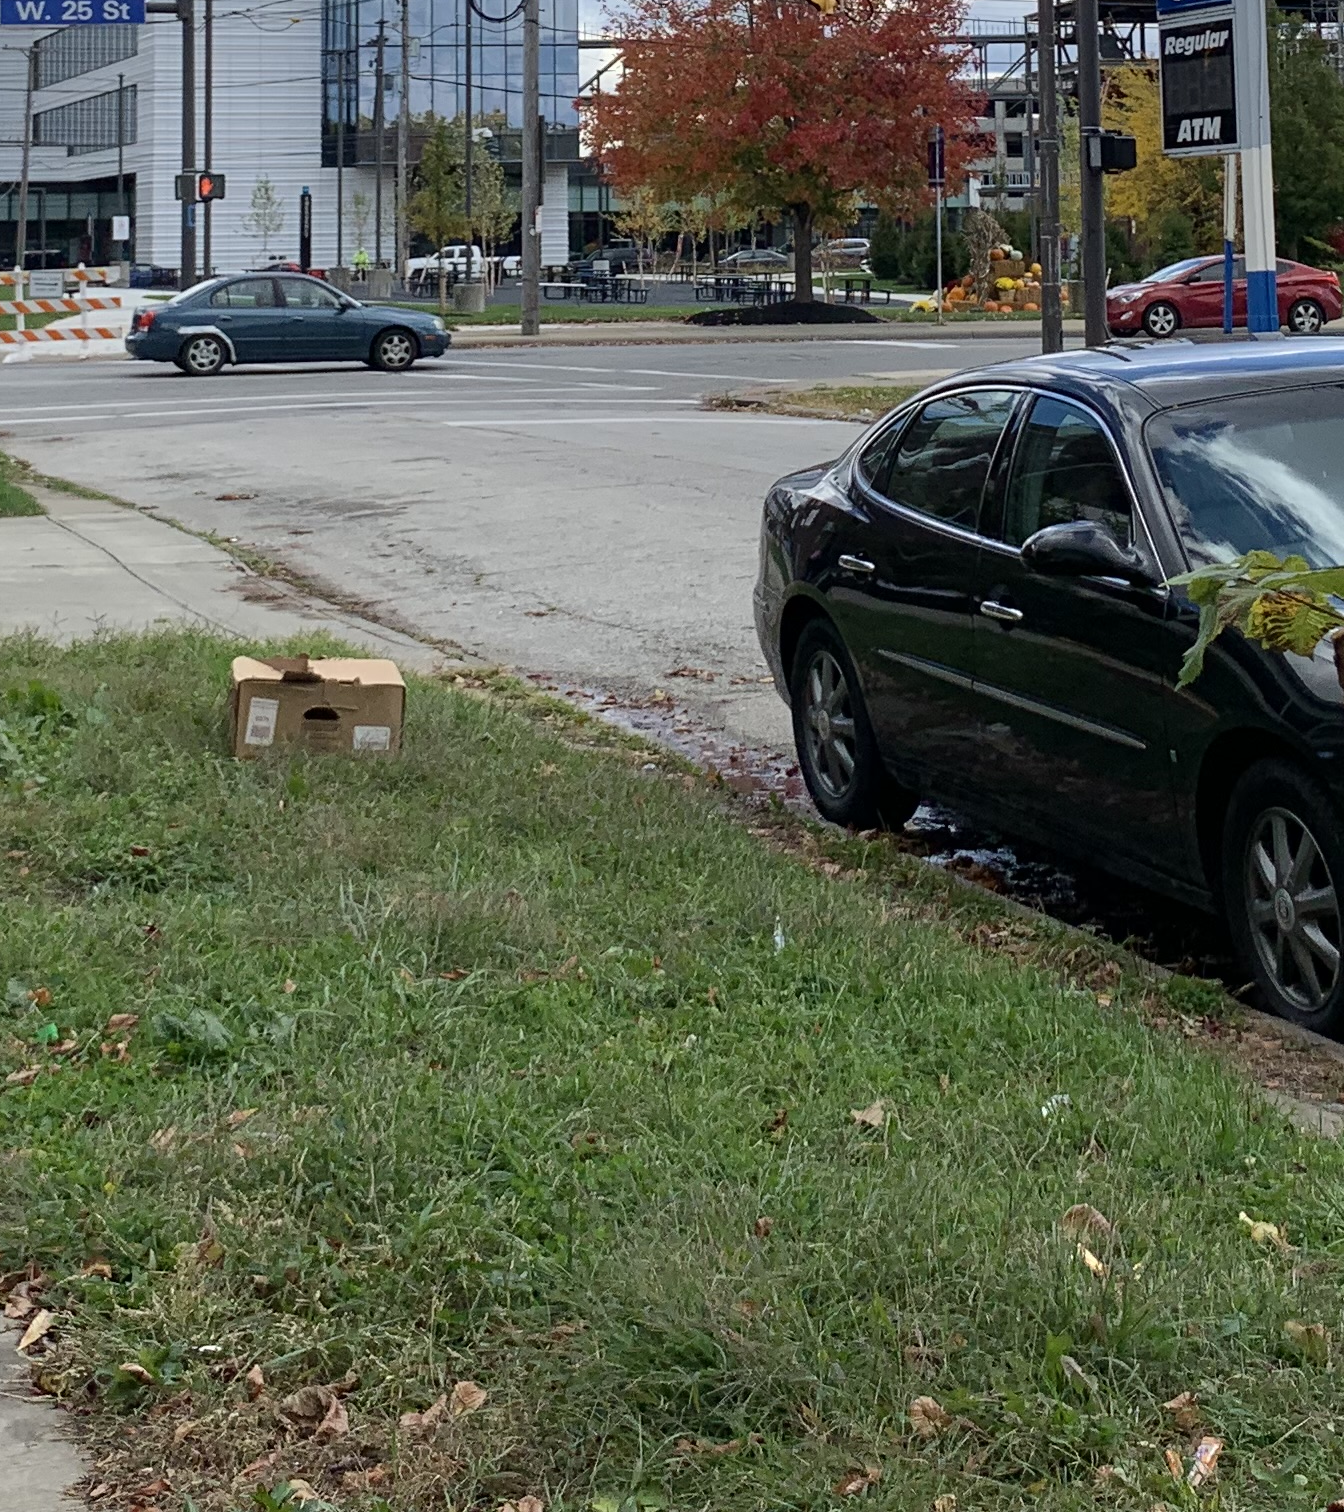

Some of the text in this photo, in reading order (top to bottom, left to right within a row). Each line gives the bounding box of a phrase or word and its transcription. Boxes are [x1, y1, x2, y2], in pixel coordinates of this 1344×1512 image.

[16, 0, 131, 21] W. 25 St
[1164, 30, 1230, 56] Regular
[1176, 116, 1222, 143] ATM
